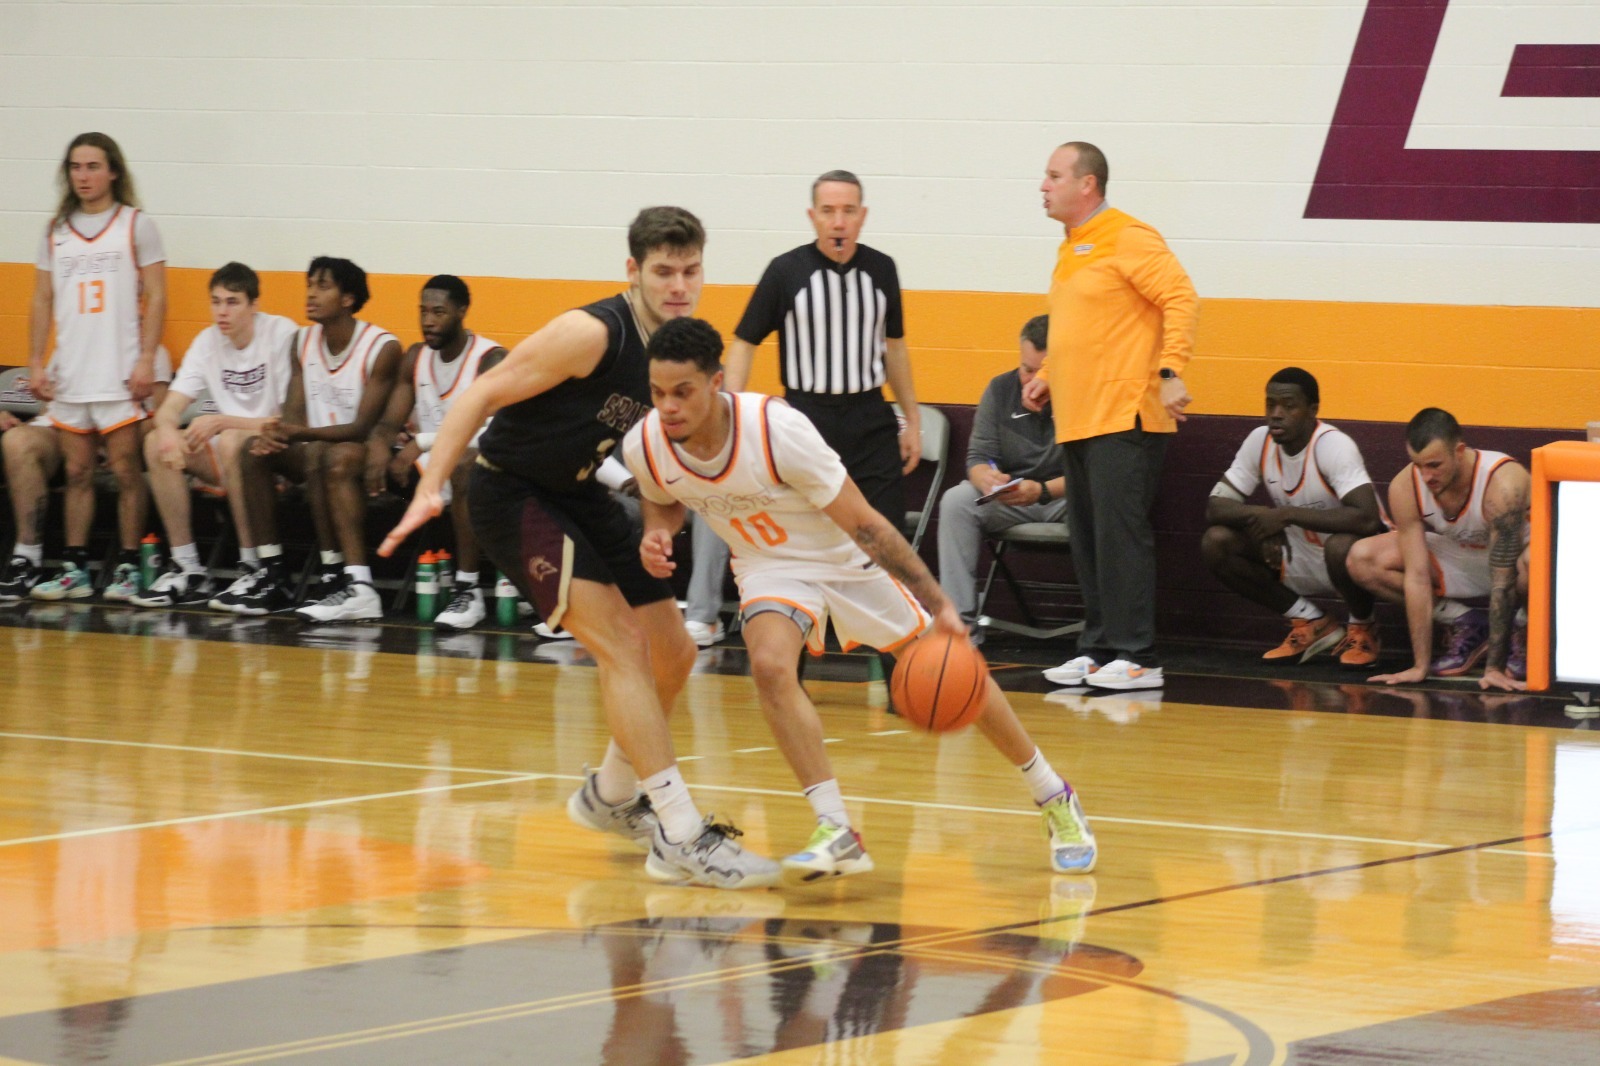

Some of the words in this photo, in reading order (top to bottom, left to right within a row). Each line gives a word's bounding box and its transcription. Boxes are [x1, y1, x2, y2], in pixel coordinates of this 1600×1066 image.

[78, 280, 105, 315] 13
[596, 393, 652, 433] SPA
[729, 511, 788, 551] 10
